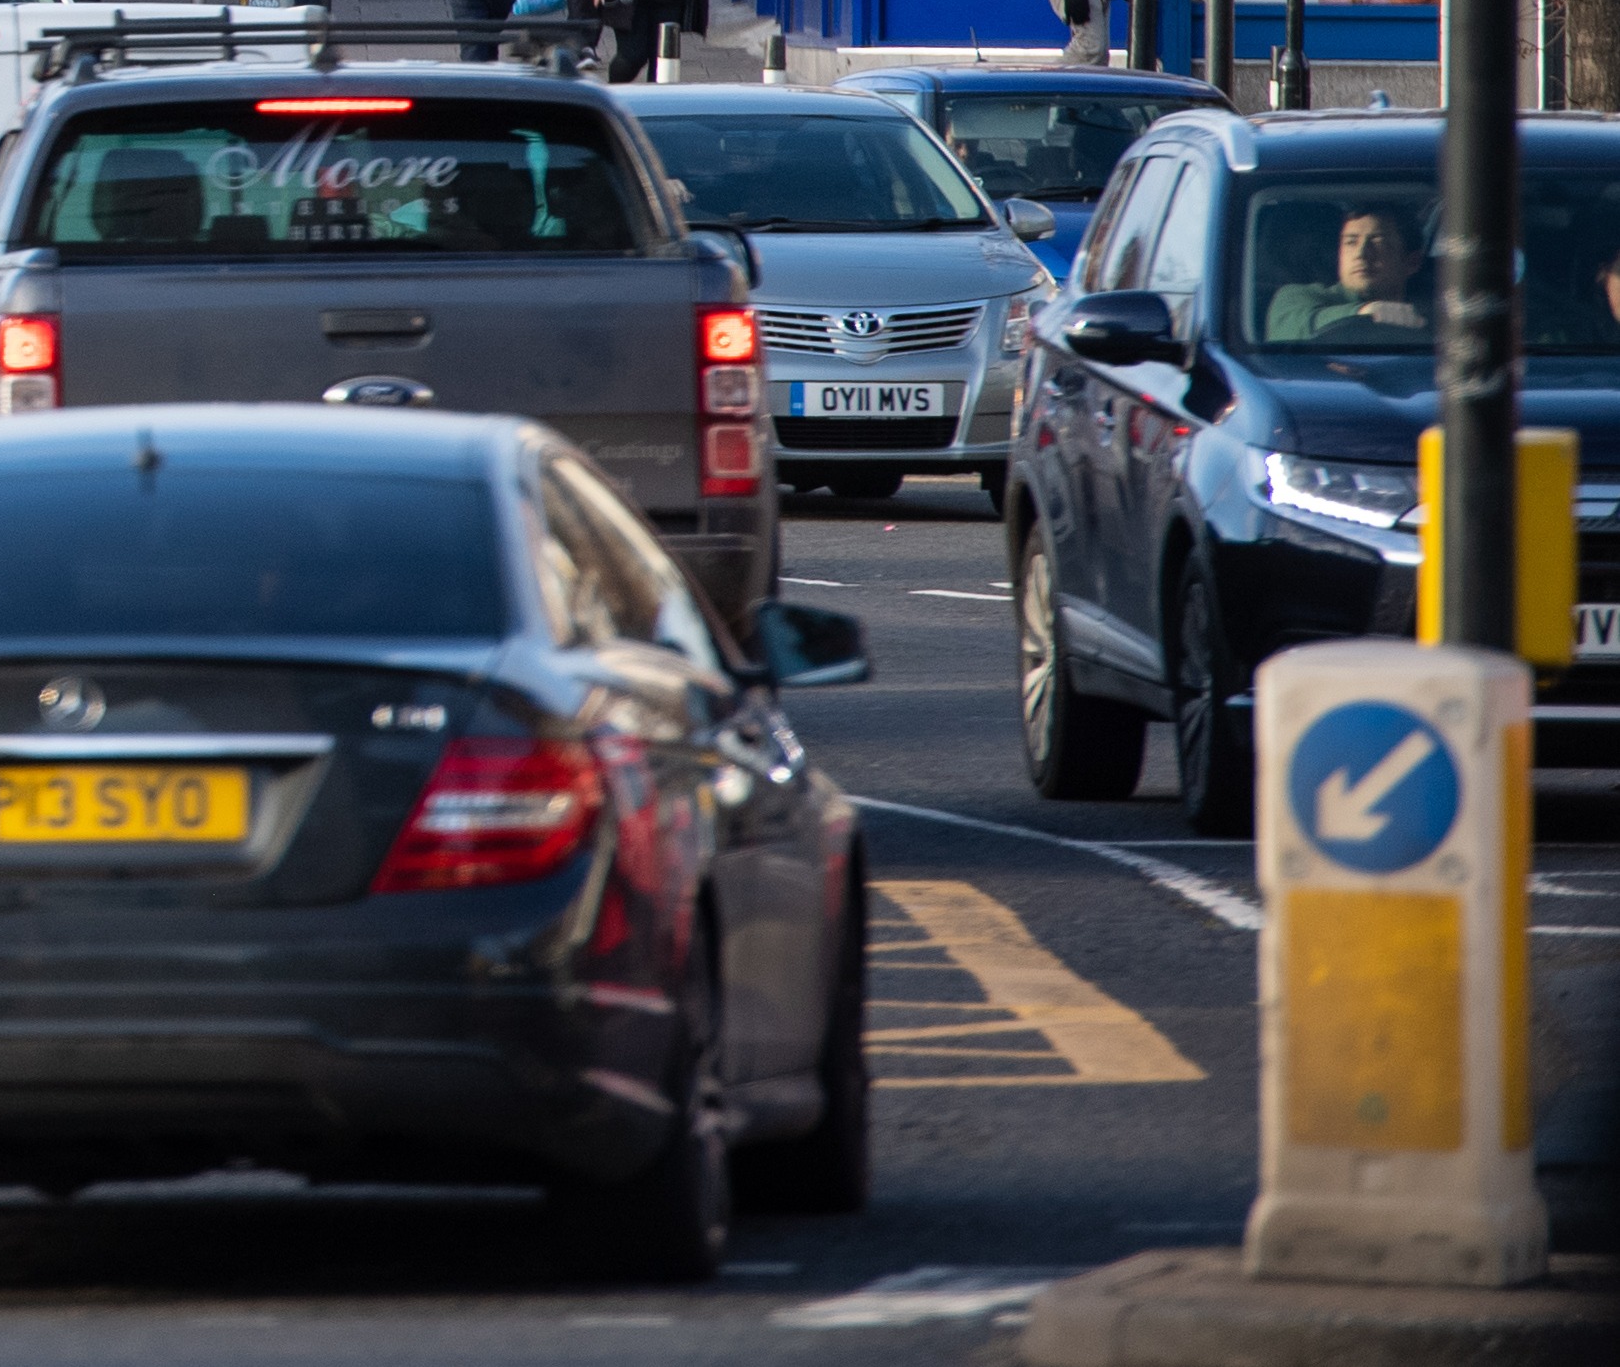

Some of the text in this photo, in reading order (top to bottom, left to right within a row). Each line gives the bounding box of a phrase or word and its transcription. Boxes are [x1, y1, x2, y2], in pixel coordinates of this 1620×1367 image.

[210, 118, 460, 191] Moore
[822, 387, 931, 411] OY11 MVS
